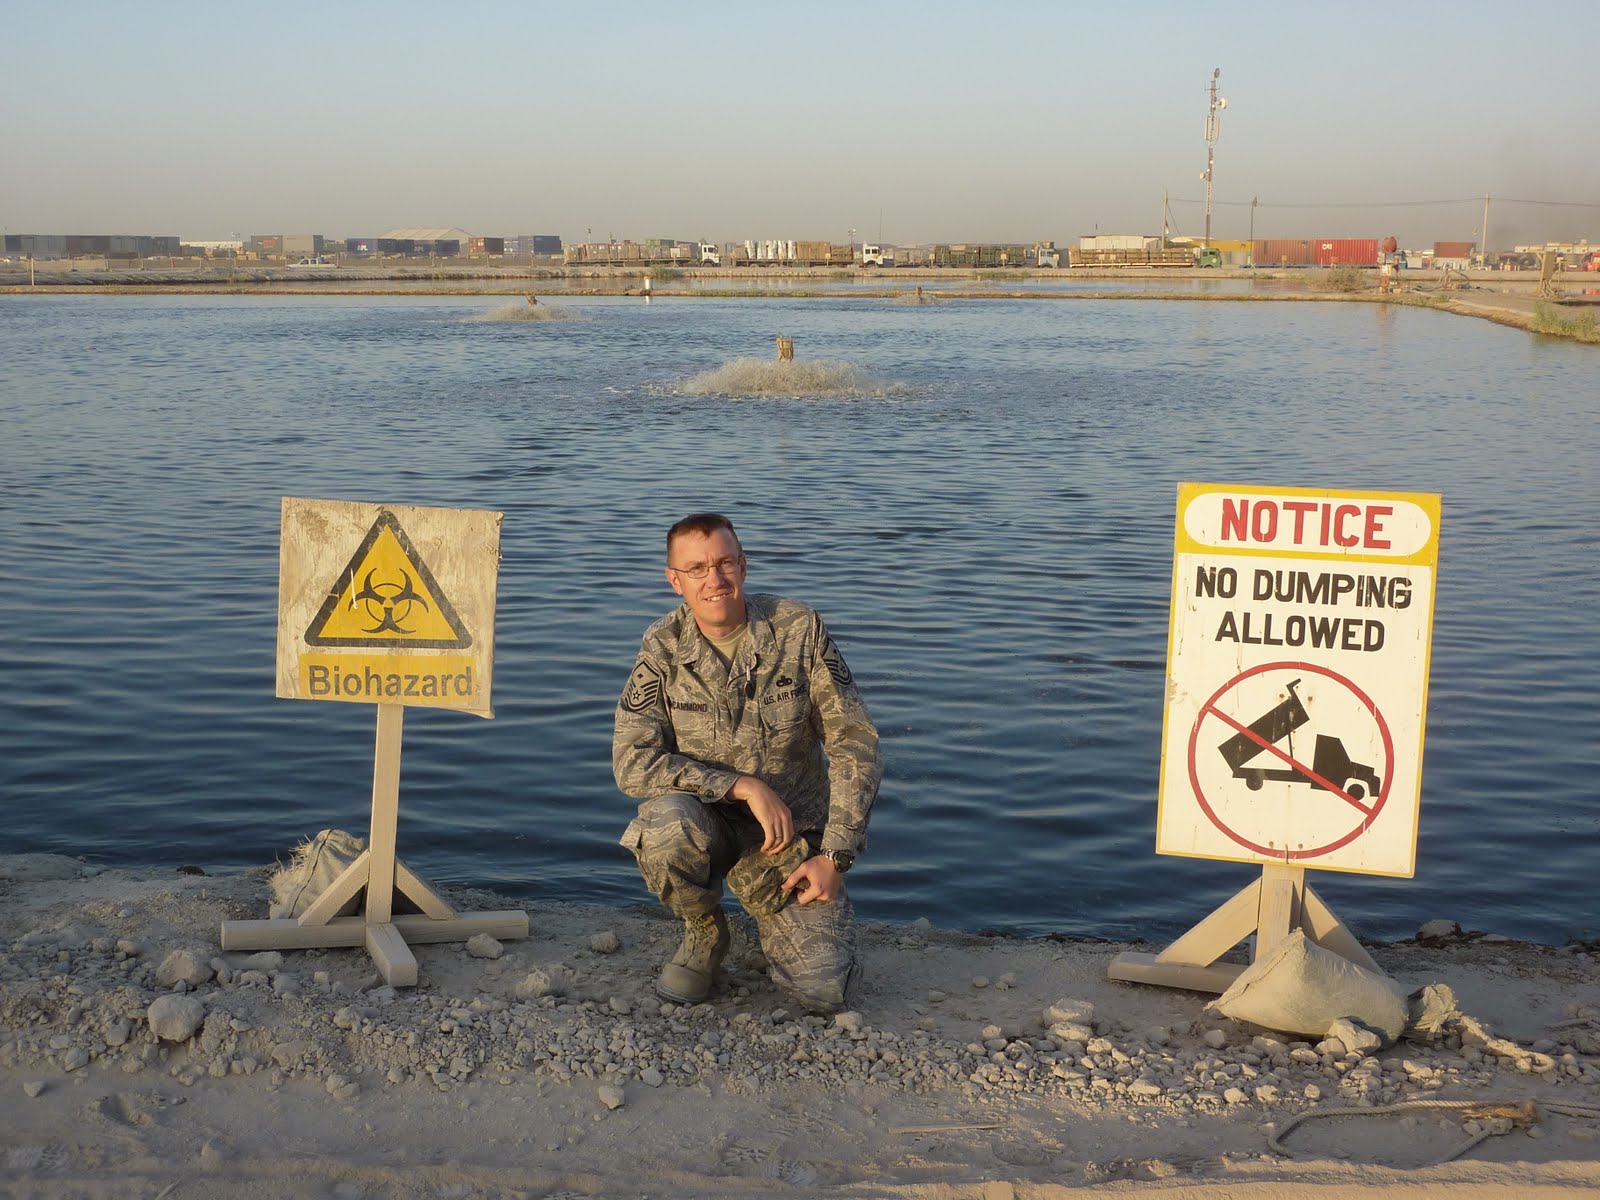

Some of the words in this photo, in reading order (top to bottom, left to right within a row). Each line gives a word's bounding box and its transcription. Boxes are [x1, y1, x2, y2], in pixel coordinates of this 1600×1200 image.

[1221, 498, 1393, 549] NOTICE
[1195, 566, 1237, 599] NO
[1253, 569, 1412, 609] DUMPING
[1215, 611, 1385, 652] ALLOWED
[308, 665, 472, 697] Biohazard
[763, 695, 776, 705] U.S.
[777, 691, 790, 702] AIR
